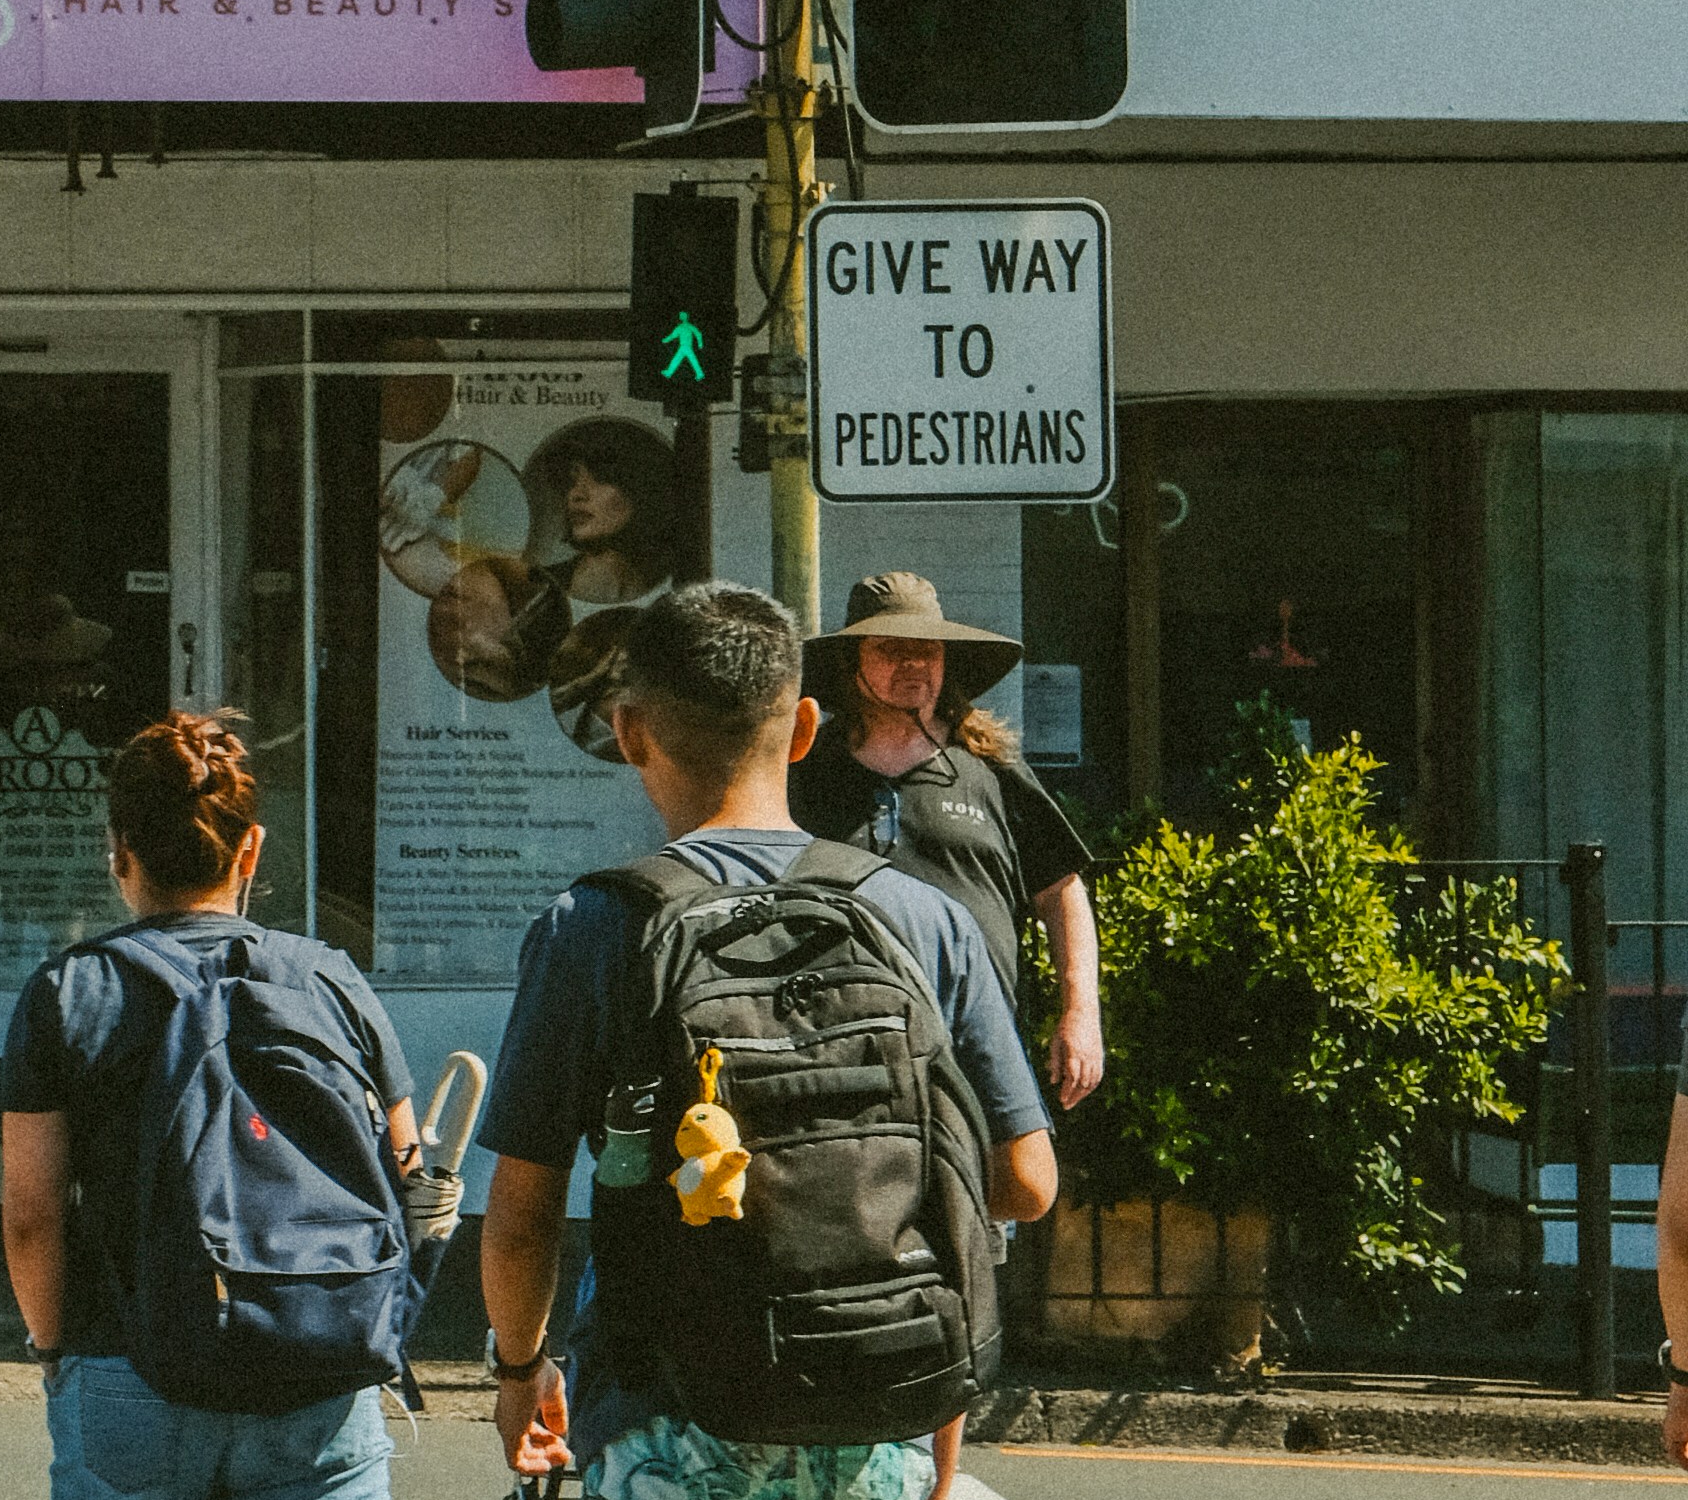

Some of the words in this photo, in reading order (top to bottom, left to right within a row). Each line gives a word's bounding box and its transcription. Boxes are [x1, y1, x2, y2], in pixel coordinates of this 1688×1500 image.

[826, 240, 951, 296] GIVE
[978, 239, 1087, 294] WAY
[923, 323, 994, 379] TO
[457, 384, 504, 405] Hair
[536, 385, 611, 410] Beauty
[835, 409, 1086, 467] PEDESTRIANS
[406, 726, 442, 740] Hair
[445, 726, 510, 741] Services
[398, 843, 451, 862] Beauty
[456, 844, 521, 859] Services
